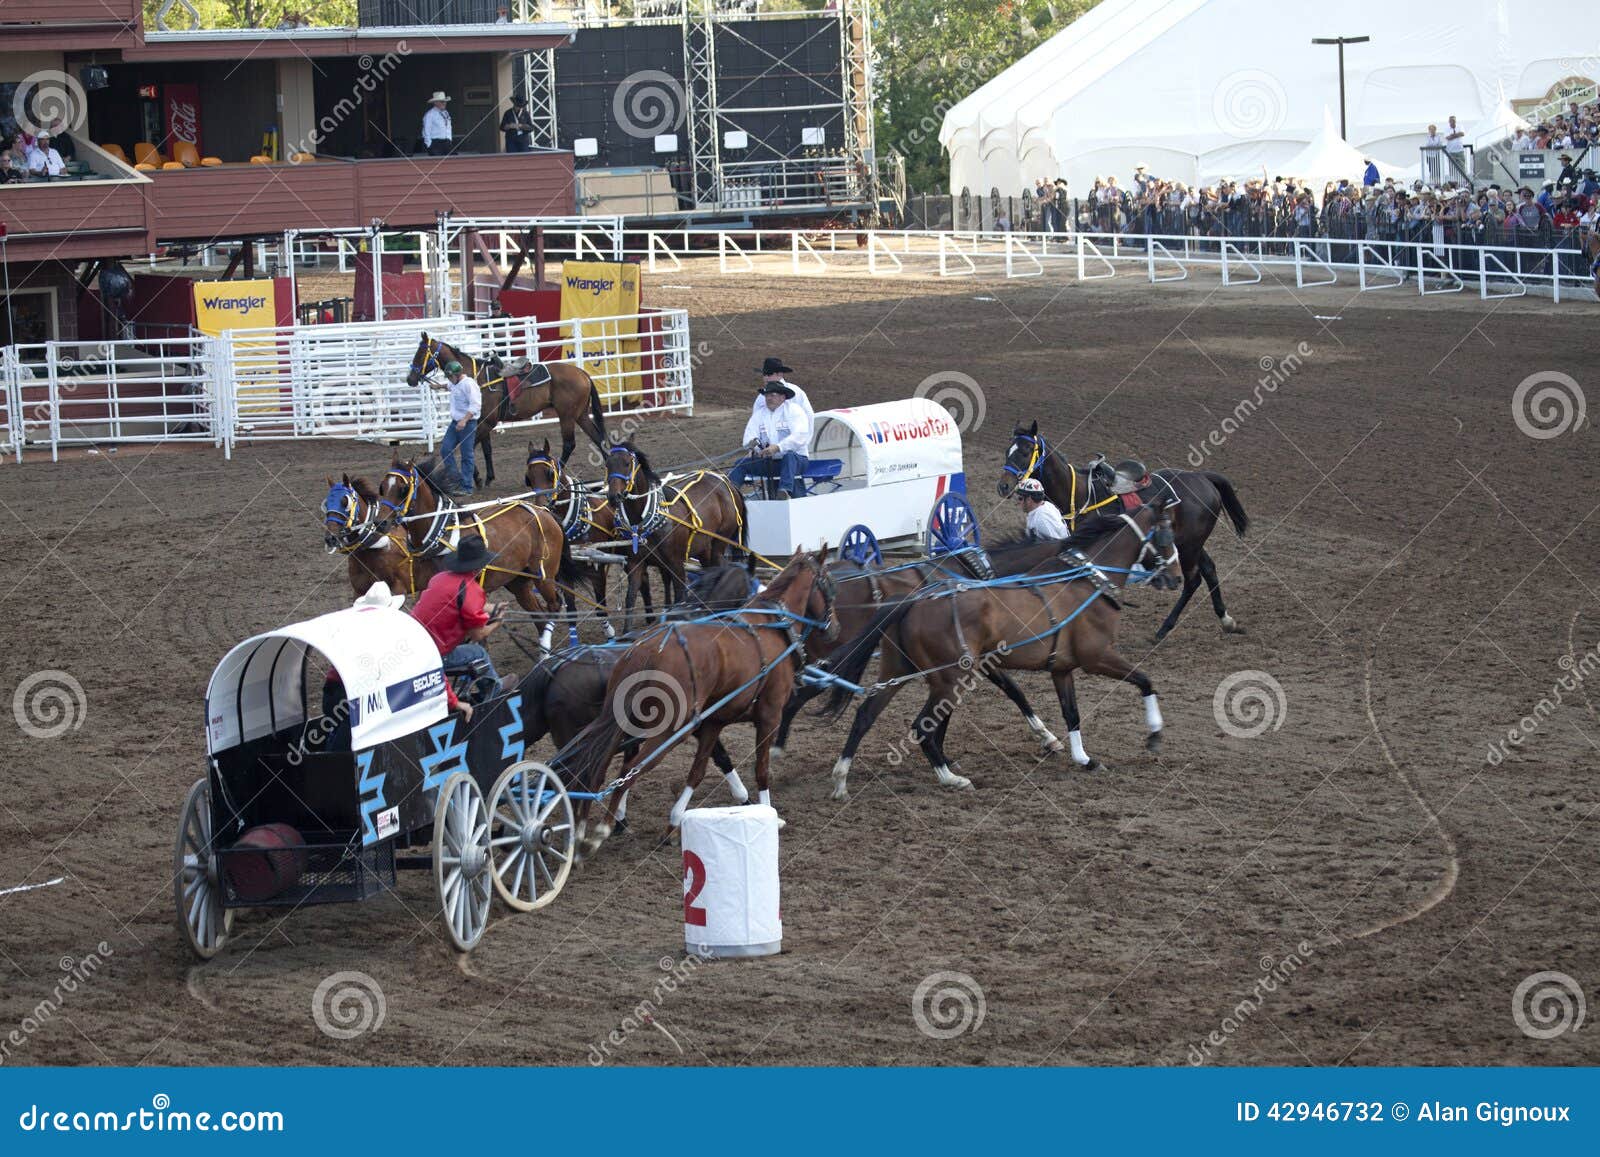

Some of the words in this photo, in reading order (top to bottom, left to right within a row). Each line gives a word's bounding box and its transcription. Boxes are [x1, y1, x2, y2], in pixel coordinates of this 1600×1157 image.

[566, 276, 614, 295] Wrangler
[203, 295, 266, 314] Wrangler
[882, 416, 950, 443] Purolator
[683, 850, 706, 927] 2
